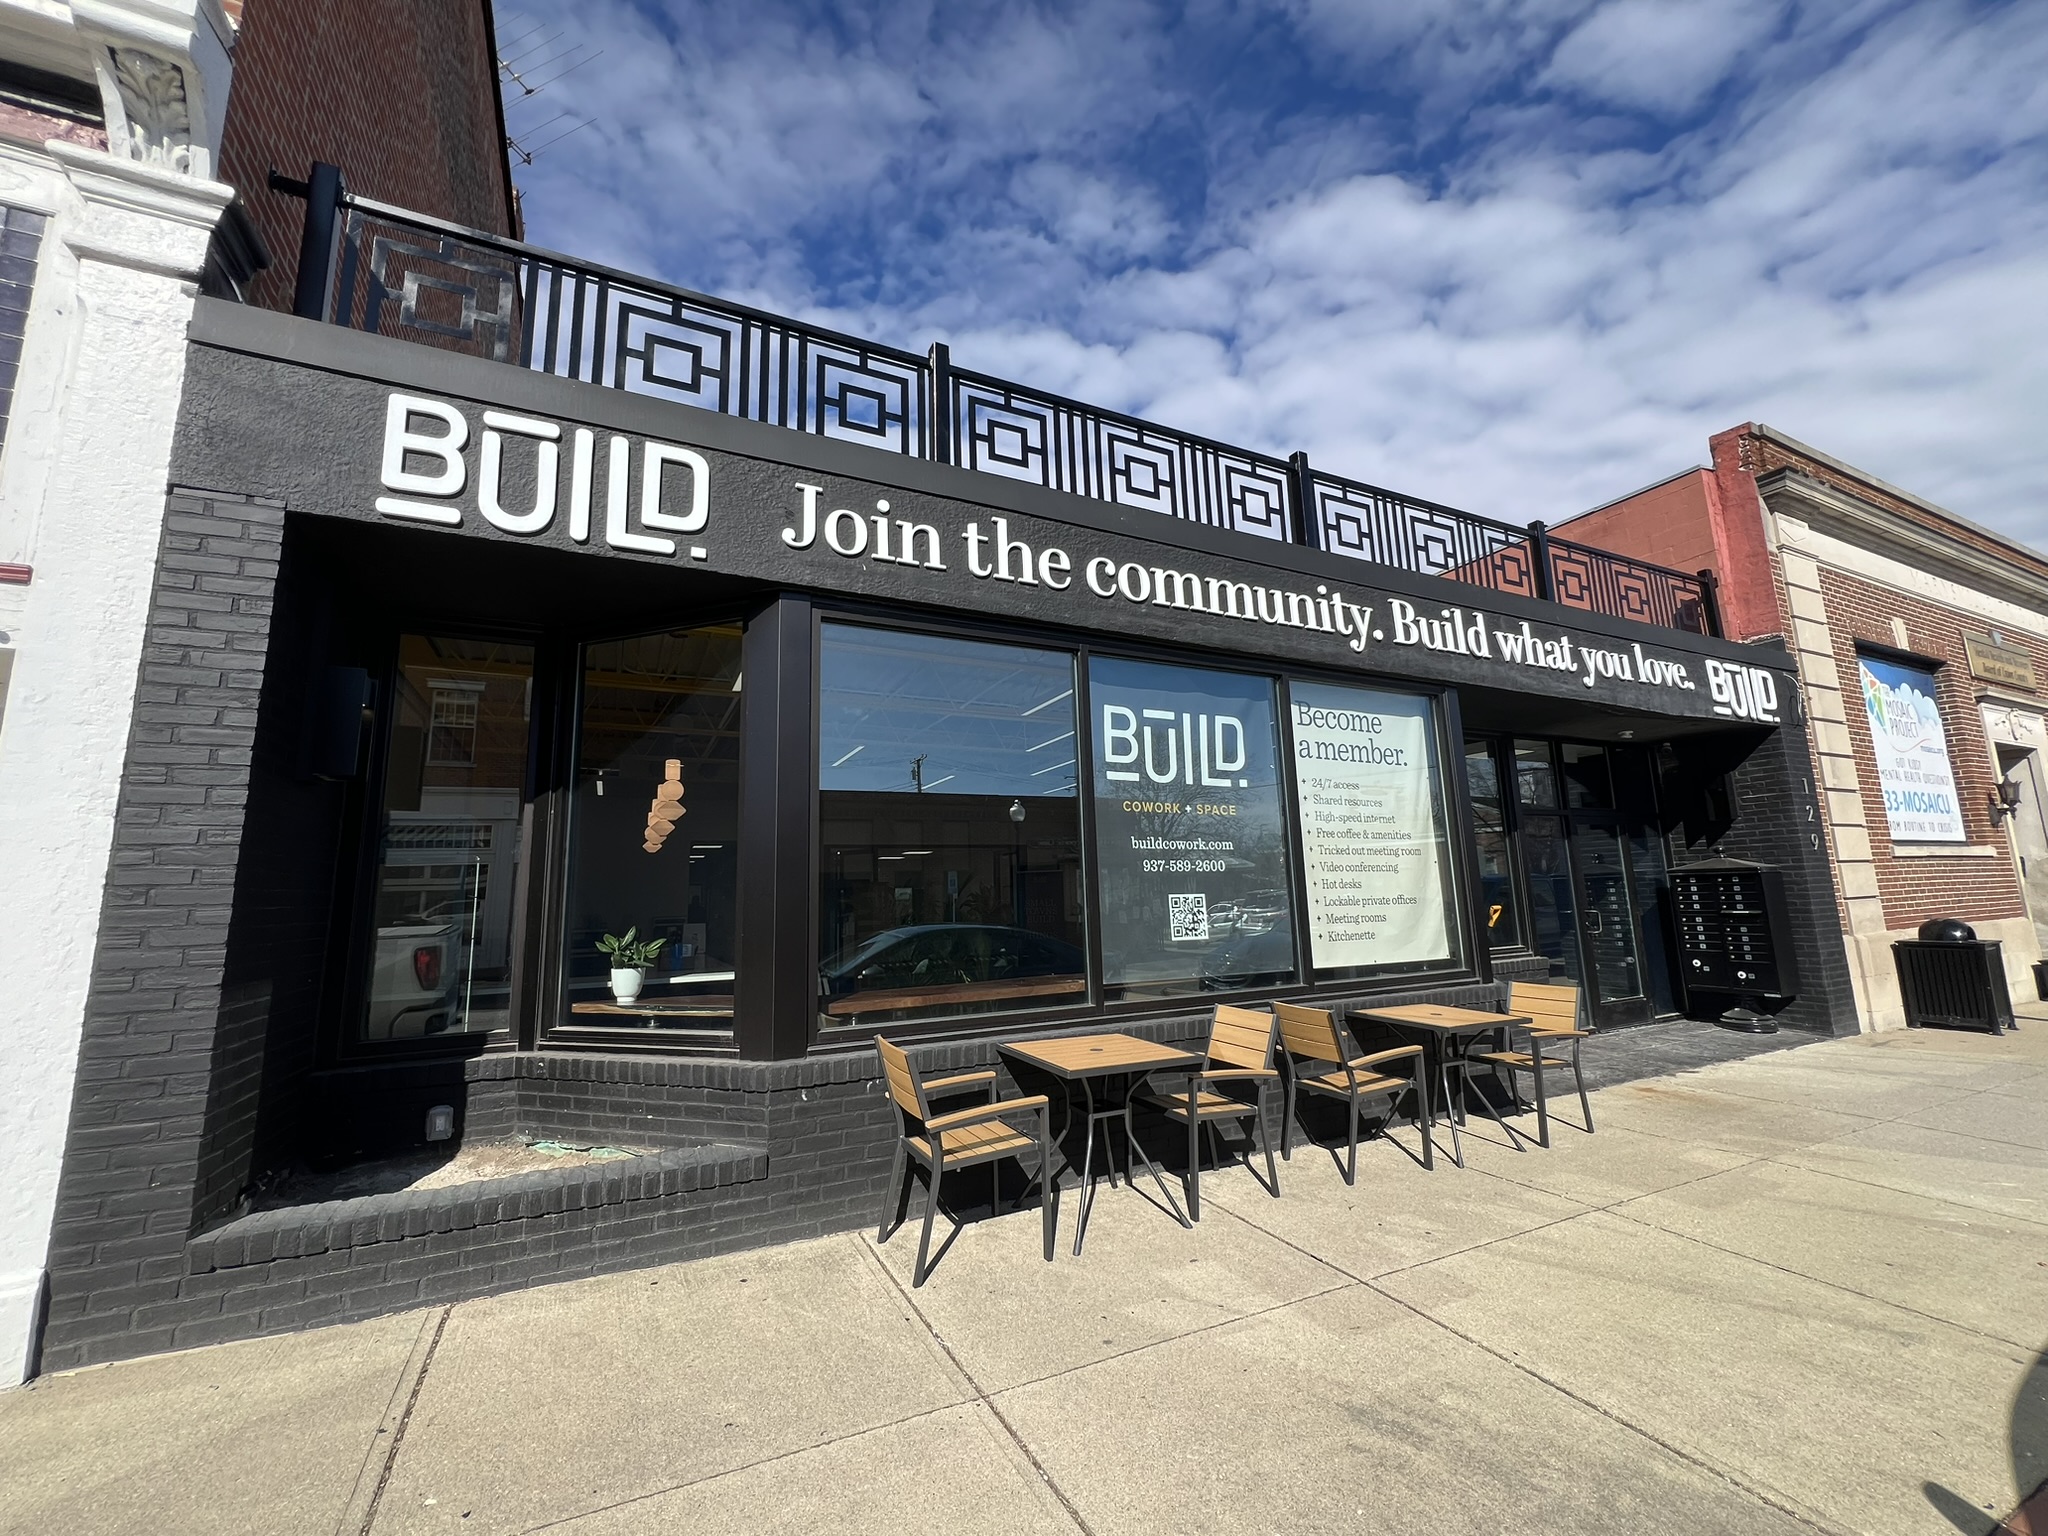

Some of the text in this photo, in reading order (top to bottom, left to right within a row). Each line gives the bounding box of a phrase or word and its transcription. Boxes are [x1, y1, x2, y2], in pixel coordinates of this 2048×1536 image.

[781, 482, 1695, 691] Join the community. Build what you love.
[1885, 699, 1913, 720] MOSAIC
[1294, 700, 1382, 734] Become
[1889, 717, 1919, 738] PROJECT
[1299, 738, 1408, 767] a member.
[1880, 769, 1902, 781] MENTAL
[1312, 778, 1360, 790] 24/7 access
[1313, 794, 1382, 808] Shared resources
[1884, 790, 1951, 814] 33-MOSAICU
[1122, 801, 1180, 814] COWORK
[1196, 804, 1236, 816] SPACE
[1314, 810, 1396, 824] High-speed internet
[1888, 820, 1902, 832] ROM
[1316, 828, 1412, 840] Free coffee & amenities
[1131, 836, 1234, 850] buildcowork.com
[1318, 844, 1422, 858] Tricked out meeting room
[1143, 860, 1226, 872] 937-589-2600
[1320, 862, 1399, 874] Video conferencing
[1322, 878, 1362, 889] Hot desks
[1324, 894, 1418, 908] Lockable private offices
[1326, 913, 1386, 925] Meeting rooms
[1328, 930, 1376, 942] Kitchenette
